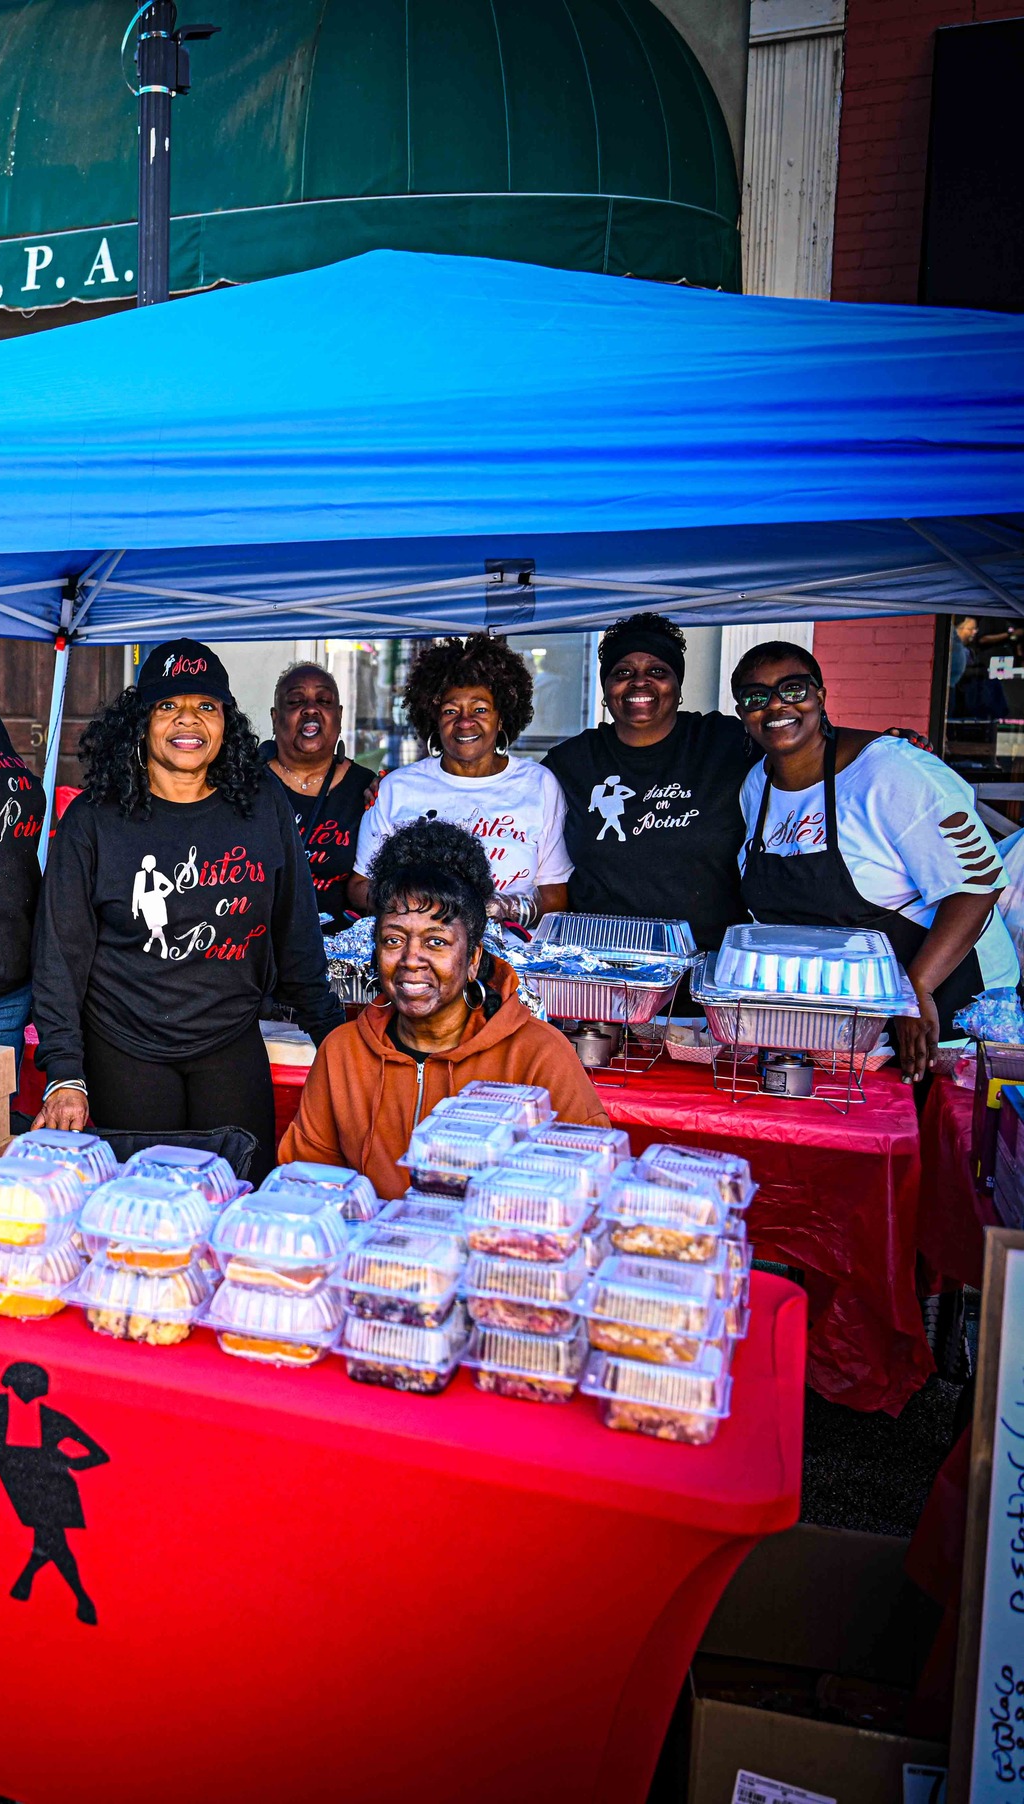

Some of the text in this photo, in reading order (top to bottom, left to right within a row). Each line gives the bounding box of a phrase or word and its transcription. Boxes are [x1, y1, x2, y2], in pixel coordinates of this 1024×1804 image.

[21, 245, 66, 292] P.
[84, 237, 134, 286] A.
[171, 654, 208, 678] SOP
[7, 775, 32, 792] on
[643, 782, 692, 803] Sisters
[655, 799, 671, 811] on
[632, 808, 700, 836] Point
[173, 845, 265, 894] Sisters
[215, 896, 252, 917] on
[169, 921, 267, 961] Point
